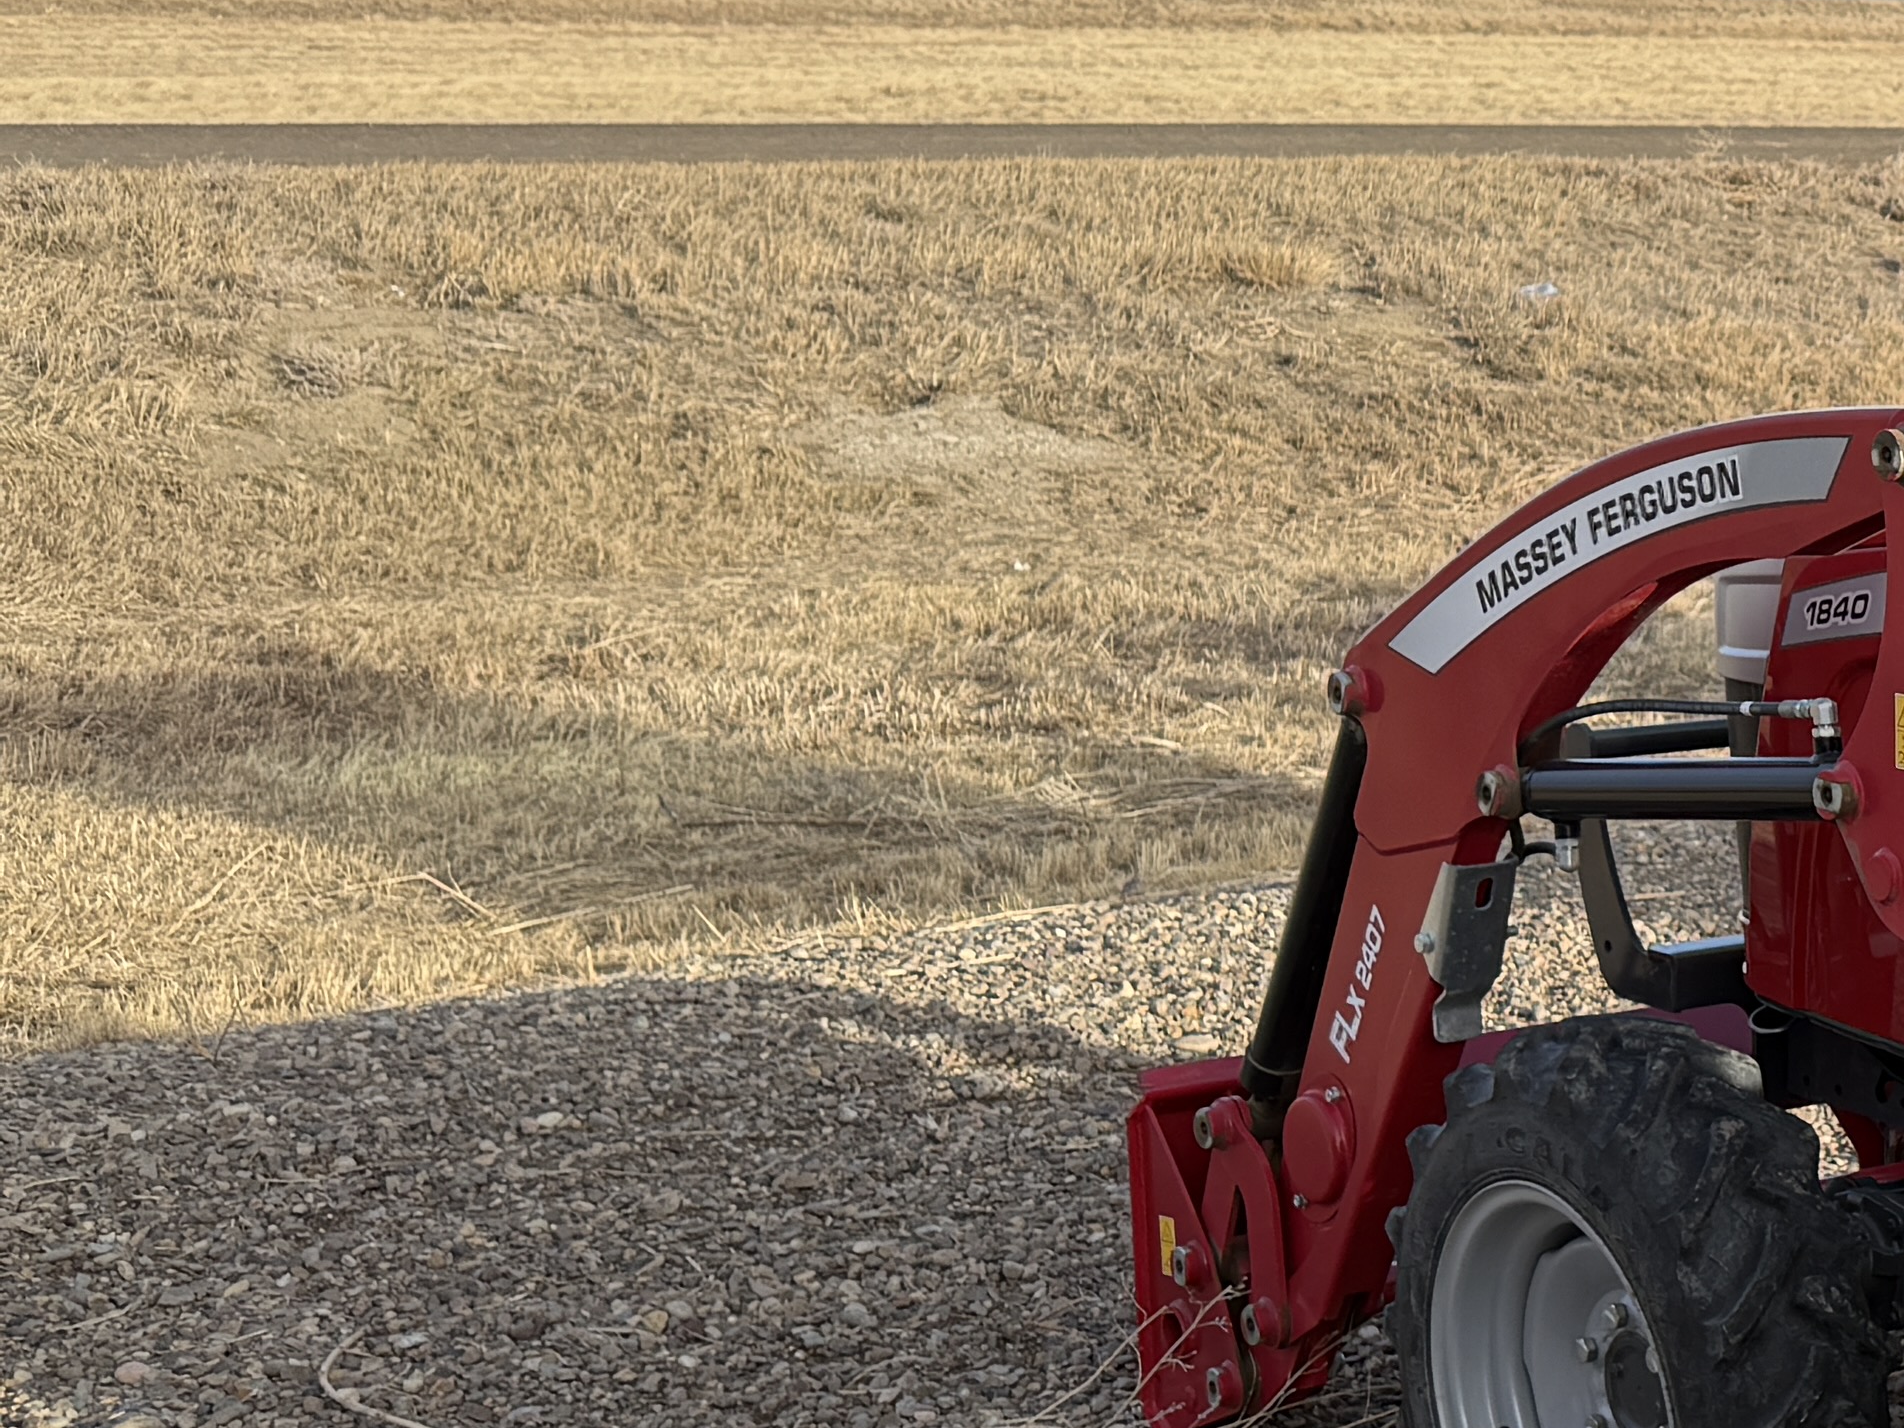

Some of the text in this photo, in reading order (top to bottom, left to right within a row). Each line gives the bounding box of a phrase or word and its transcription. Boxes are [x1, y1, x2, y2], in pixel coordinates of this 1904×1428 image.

[1475, 459, 1741, 614] MASSEY FERGUSON
[1805, 592, 1868, 627] 1840
[1329, 903, 1385, 1065] FLX 2407
